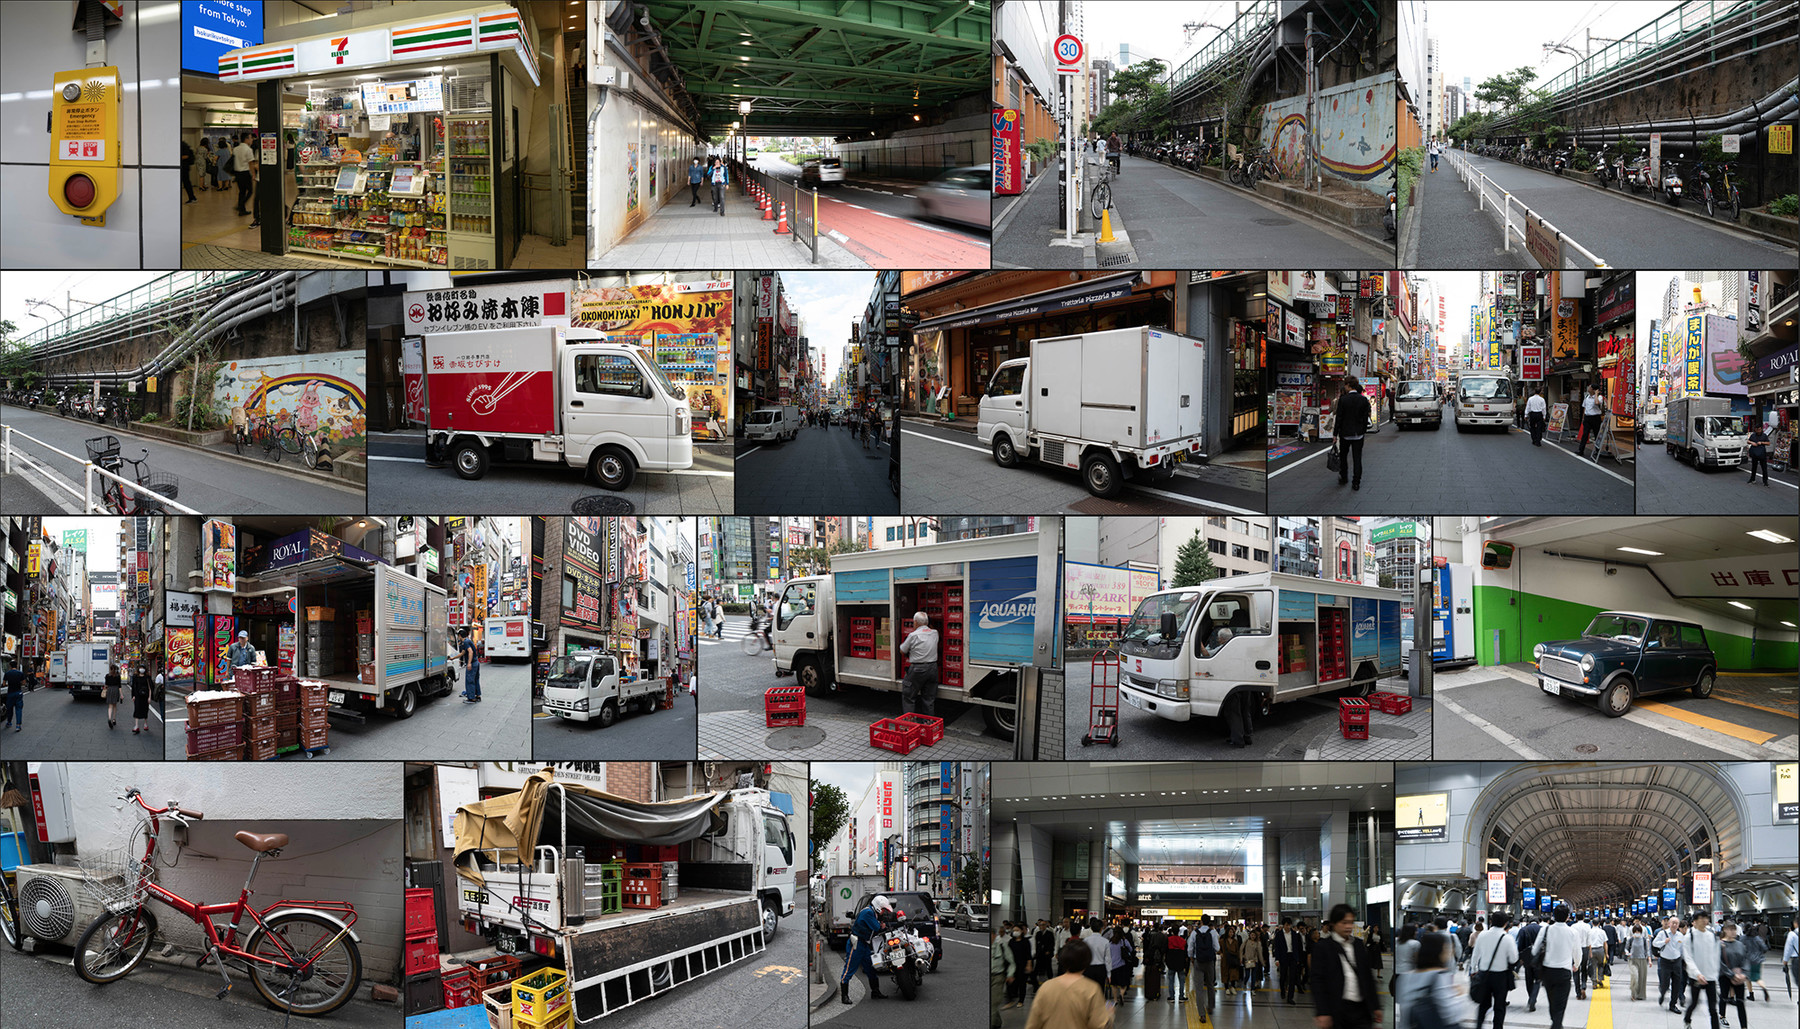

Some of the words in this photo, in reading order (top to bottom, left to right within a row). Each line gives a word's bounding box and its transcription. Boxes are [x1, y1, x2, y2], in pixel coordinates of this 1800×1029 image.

[199, 4, 221, 19] from
[222, 12, 247, 27] Tokyo.
[213, 0, 235, 9] more
[236, 5, 252, 16] step
[1060, 42, 1078, 56] 30
[706, 281, 731, 289] 7F/8F
[427, 296, 540, 322] お好み焼本陣
[1061, 297, 1085, 307] Trattoria
[581, 309, 640, 322] OKONOMIYAKI
[1687, 316, 1701, 390] まんが喫茶
[449, 360, 501, 368] 赤坂ちびすけ
[466, 386, 478, 402] Since
[1624, 361, 1634, 416] 大盛り無料
[451, 519, 463, 528] 4F
[64, 530, 85, 538] レイク
[569, 522, 591, 546] DVD
[273, 541, 304, 560] ROYAL
[569, 535, 600, 563] VIDEO
[1710, 569, 1799, 587] 出庫口
[197, 616, 206, 673] カラオケ
[216, 616, 231, 674] カラオケ
[883, 781, 893, 816] ビックロ
[464, 891, 489, 902] 高圧ガス
